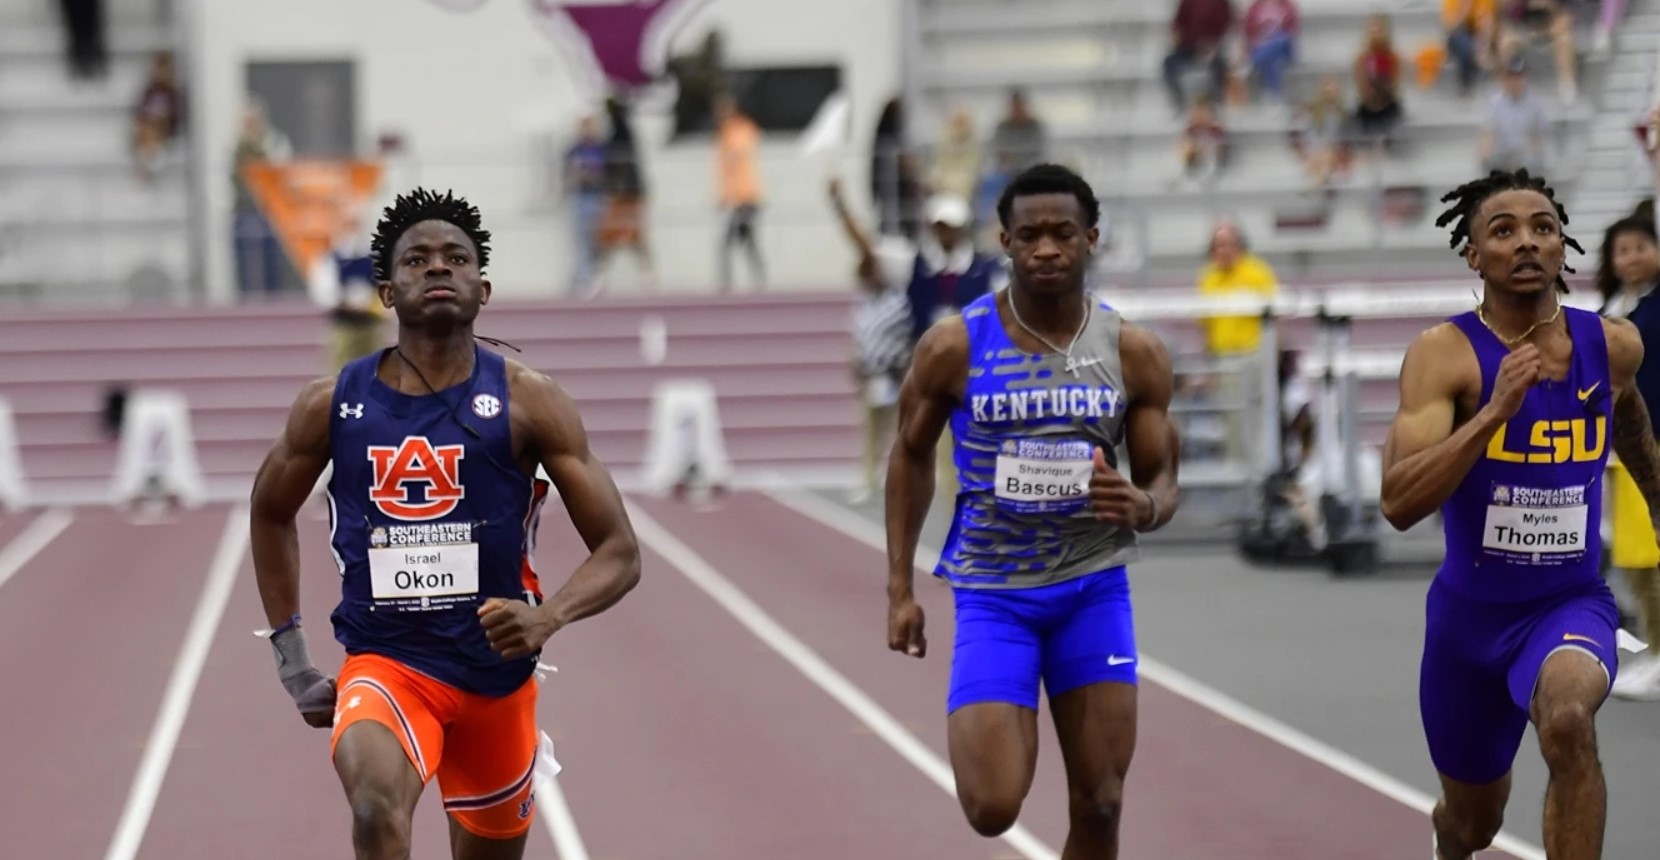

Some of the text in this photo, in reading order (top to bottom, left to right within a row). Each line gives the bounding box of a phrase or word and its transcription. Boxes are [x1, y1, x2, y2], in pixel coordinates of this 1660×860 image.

[474, 394, 501, 417] SEC
[971, 388, 1120, 422] KENTUCKY
[1486, 416, 1606, 464] LSU
[1018, 464, 1074, 477] Shavique
[1006, 477, 1082, 497] Bascus
[1512, 494, 1585, 505] CONFERENCE
[1522, 513, 1558, 526] Myles
[389, 522, 472, 536] SOUTHEASTERN
[1494, 526, 1578, 546] Thomas
[389, 532, 472, 545] CONFERENCE
[405, 553, 441, 565] Israel
[394, 571, 454, 590] Okon
